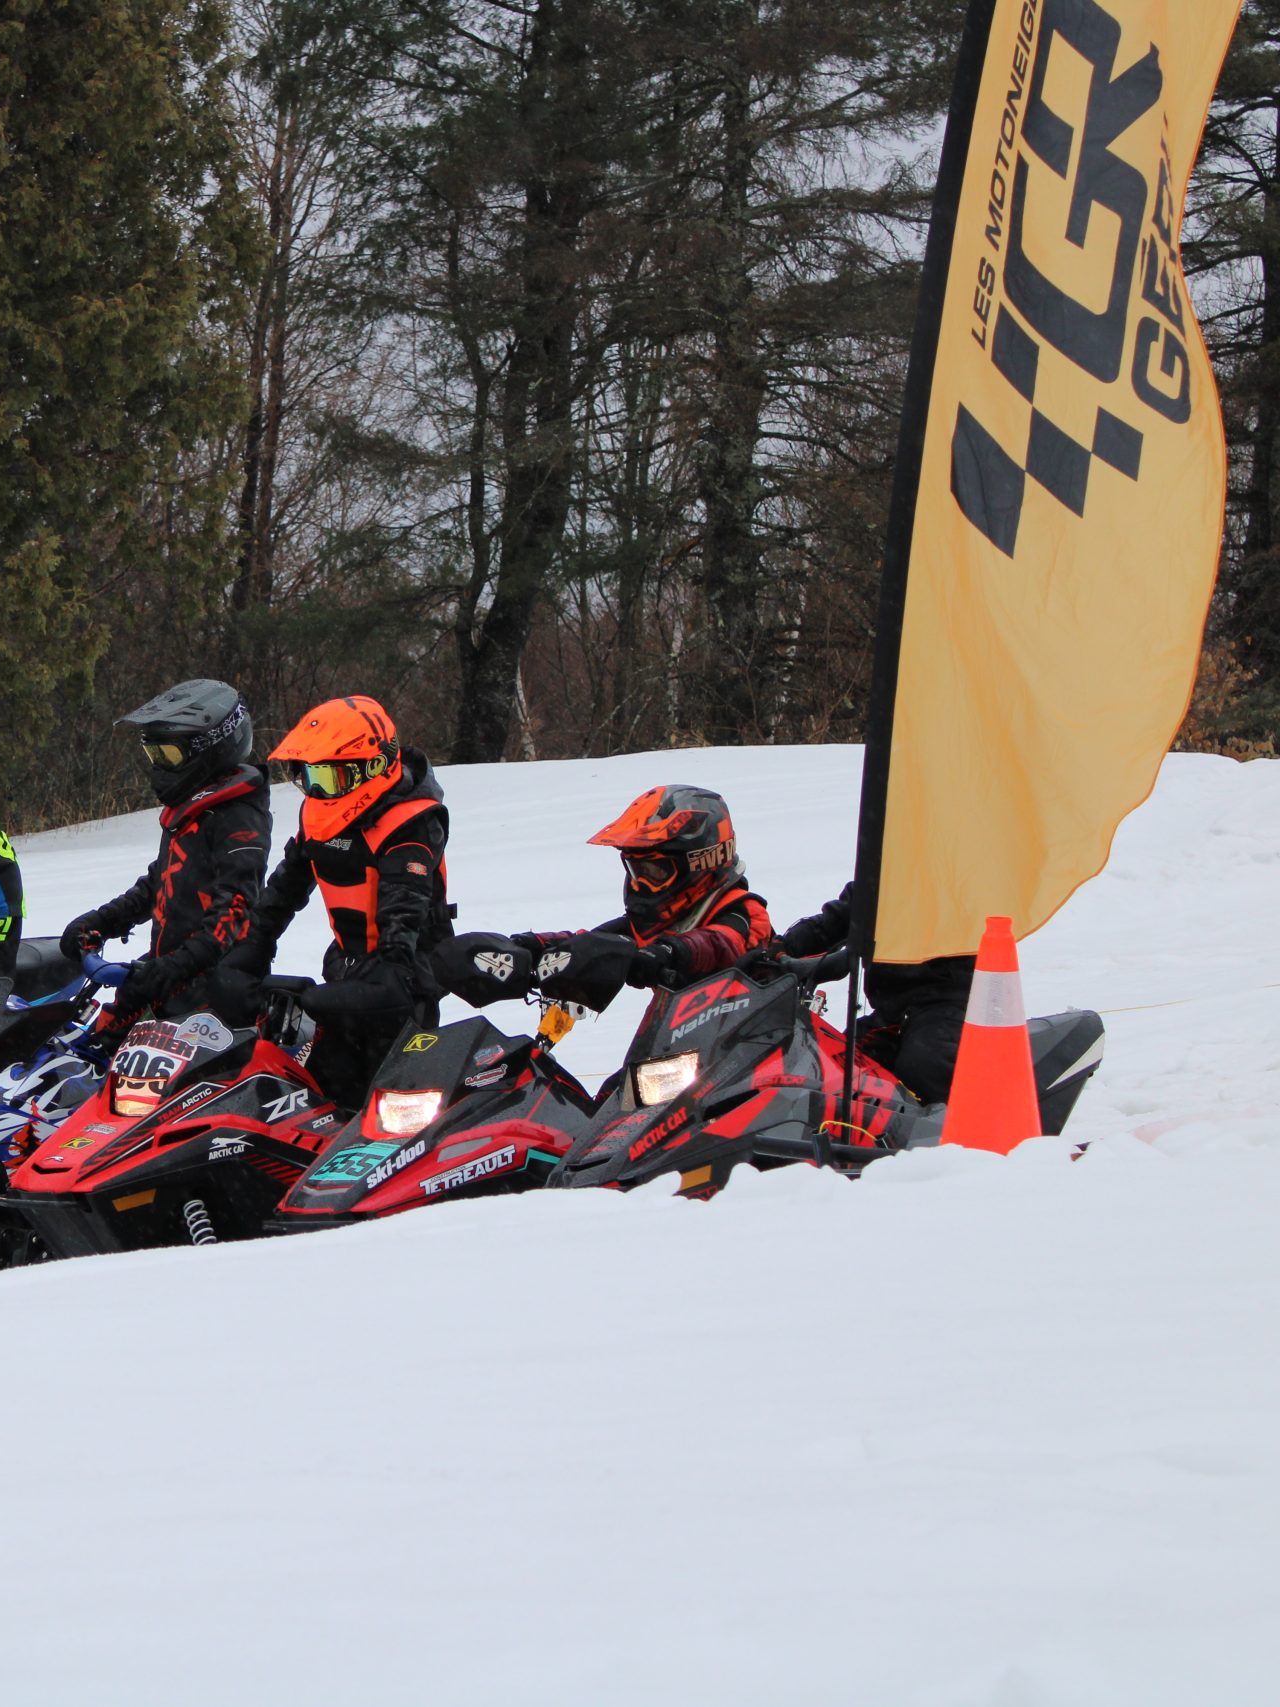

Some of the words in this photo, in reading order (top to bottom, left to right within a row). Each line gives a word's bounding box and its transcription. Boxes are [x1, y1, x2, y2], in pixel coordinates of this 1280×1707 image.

[970, 256, 996, 351] LES
[341, 792, 372, 822] FXR
[188, 1022, 220, 1041] 306
[670, 998, 750, 1045] Nathan
[114, 1050, 175, 1095] 306
[181, 1087, 213, 1110] ARCTIC
[261, 1087, 309, 1123] ZR
[311, 1114, 335, 1129] 200
[628, 1122, 669, 1161] ARCTIC
[666, 1107, 688, 1133] CAT
[208, 1147, 232, 1161] ARCTIC
[232, 1144, 245, 1154] CAT
[366, 1140, 426, 1189] ski-doo
[420, 1145, 517, 1196] TETREAULT
